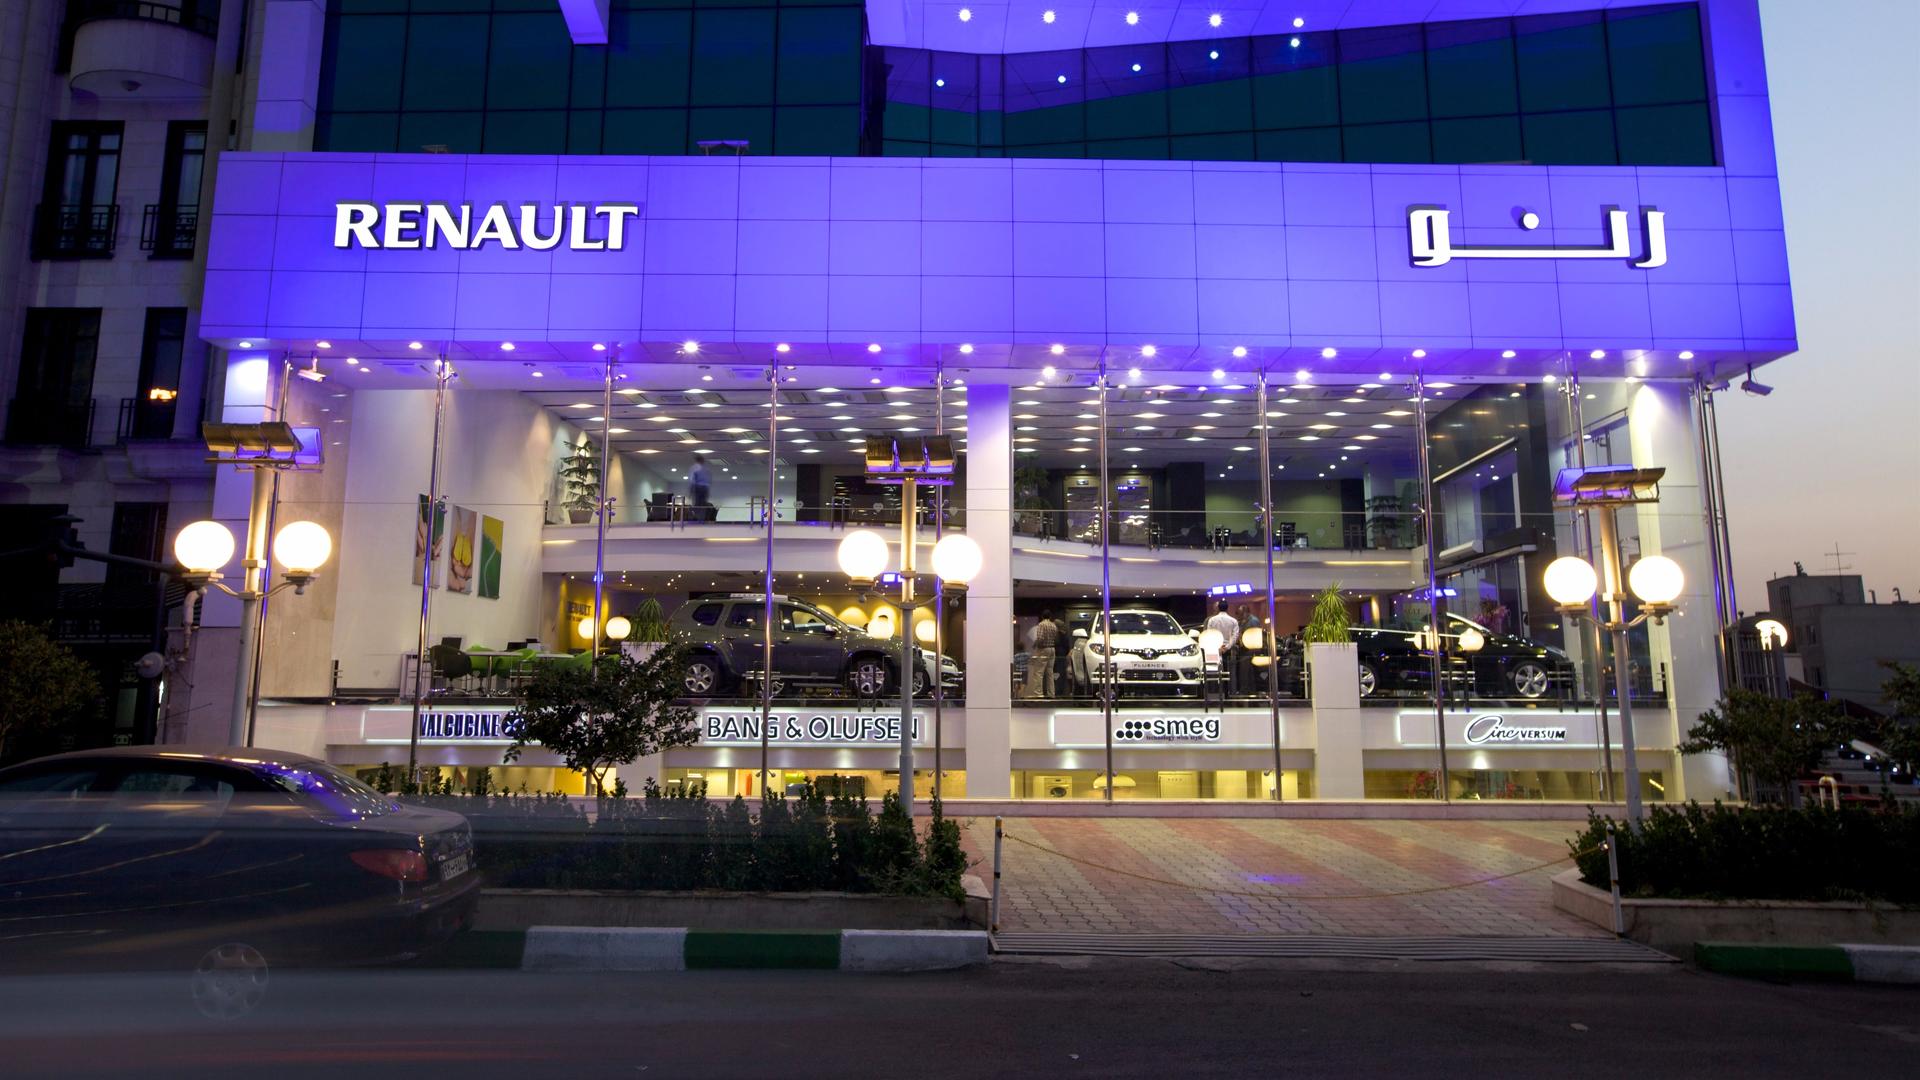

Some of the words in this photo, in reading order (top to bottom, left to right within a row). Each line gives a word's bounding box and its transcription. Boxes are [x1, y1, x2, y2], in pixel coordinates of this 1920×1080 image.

[333, 202, 640, 251] RENAULT
[708, 716, 778, 738] BANG
[786, 717, 802, 738] &
[1153, 719, 1219, 738] smeg
